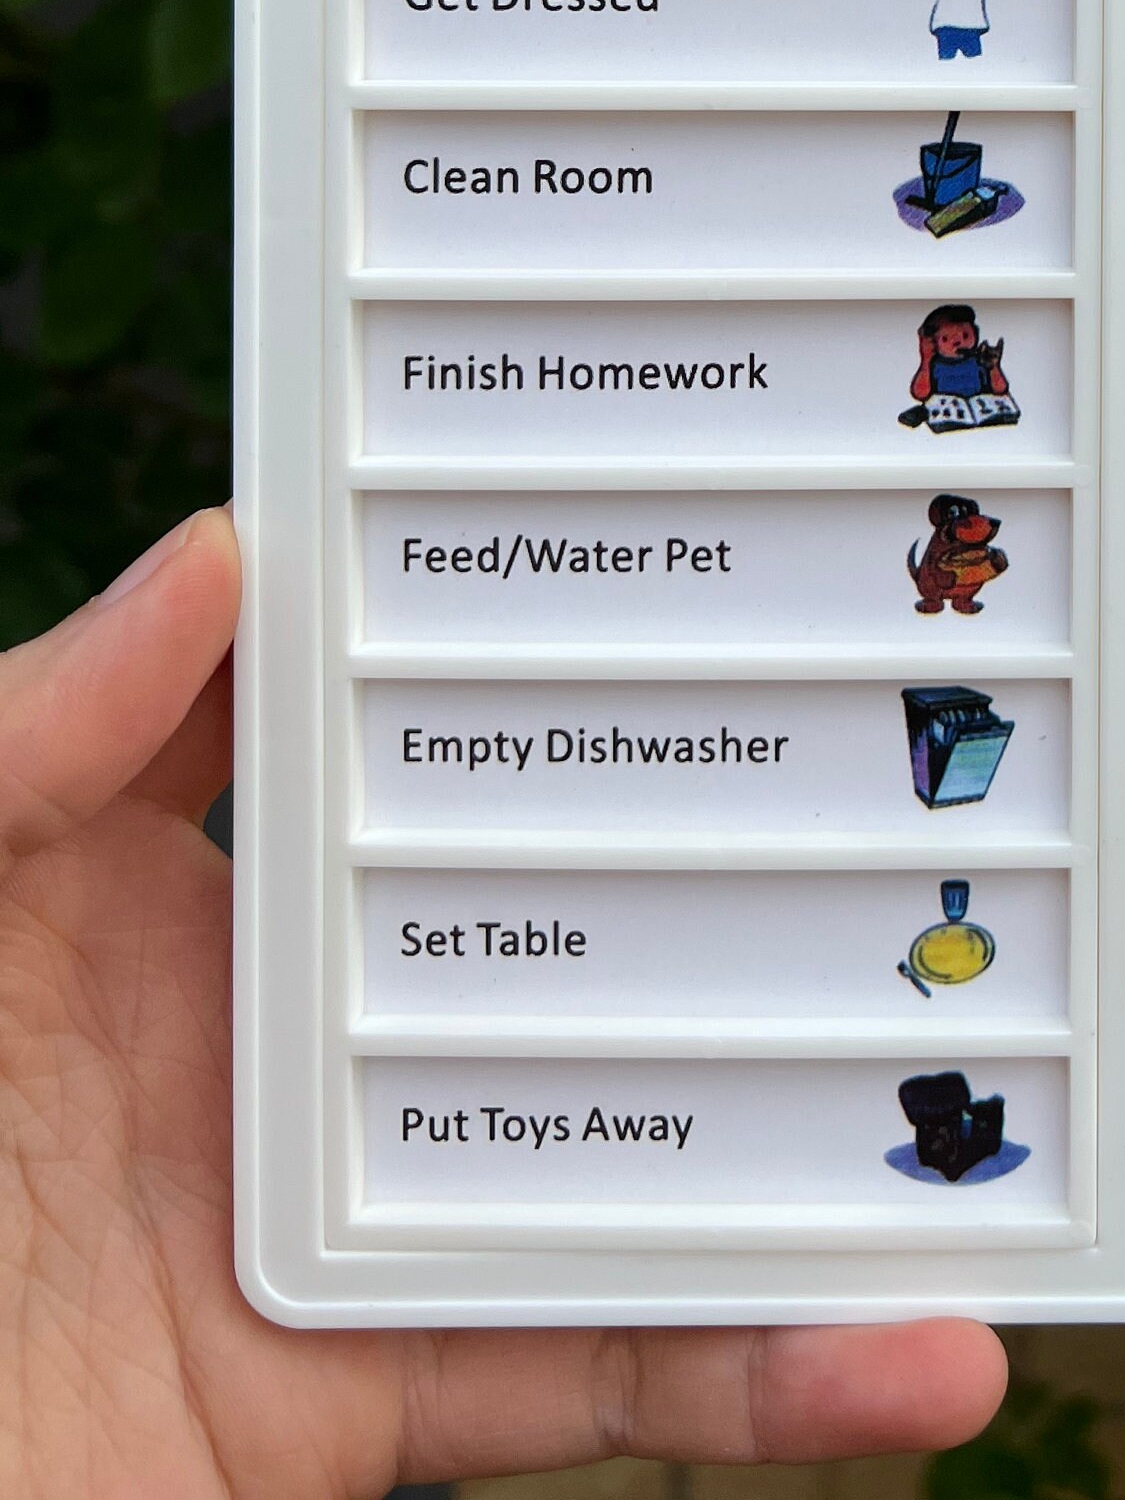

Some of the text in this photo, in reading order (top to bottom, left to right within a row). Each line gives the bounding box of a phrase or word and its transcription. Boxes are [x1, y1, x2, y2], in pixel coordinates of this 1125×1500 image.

[403, 156, 653, 195] Clean Room
[404, 352, 769, 391] Finish Homework
[403, 533, 732, 580] Feed/Water Pet
[403, 726, 790, 772] Empty Dishwasher
[400, 919, 587, 957] Set Table
[402, 1106, 694, 1150] Put Toys Away
